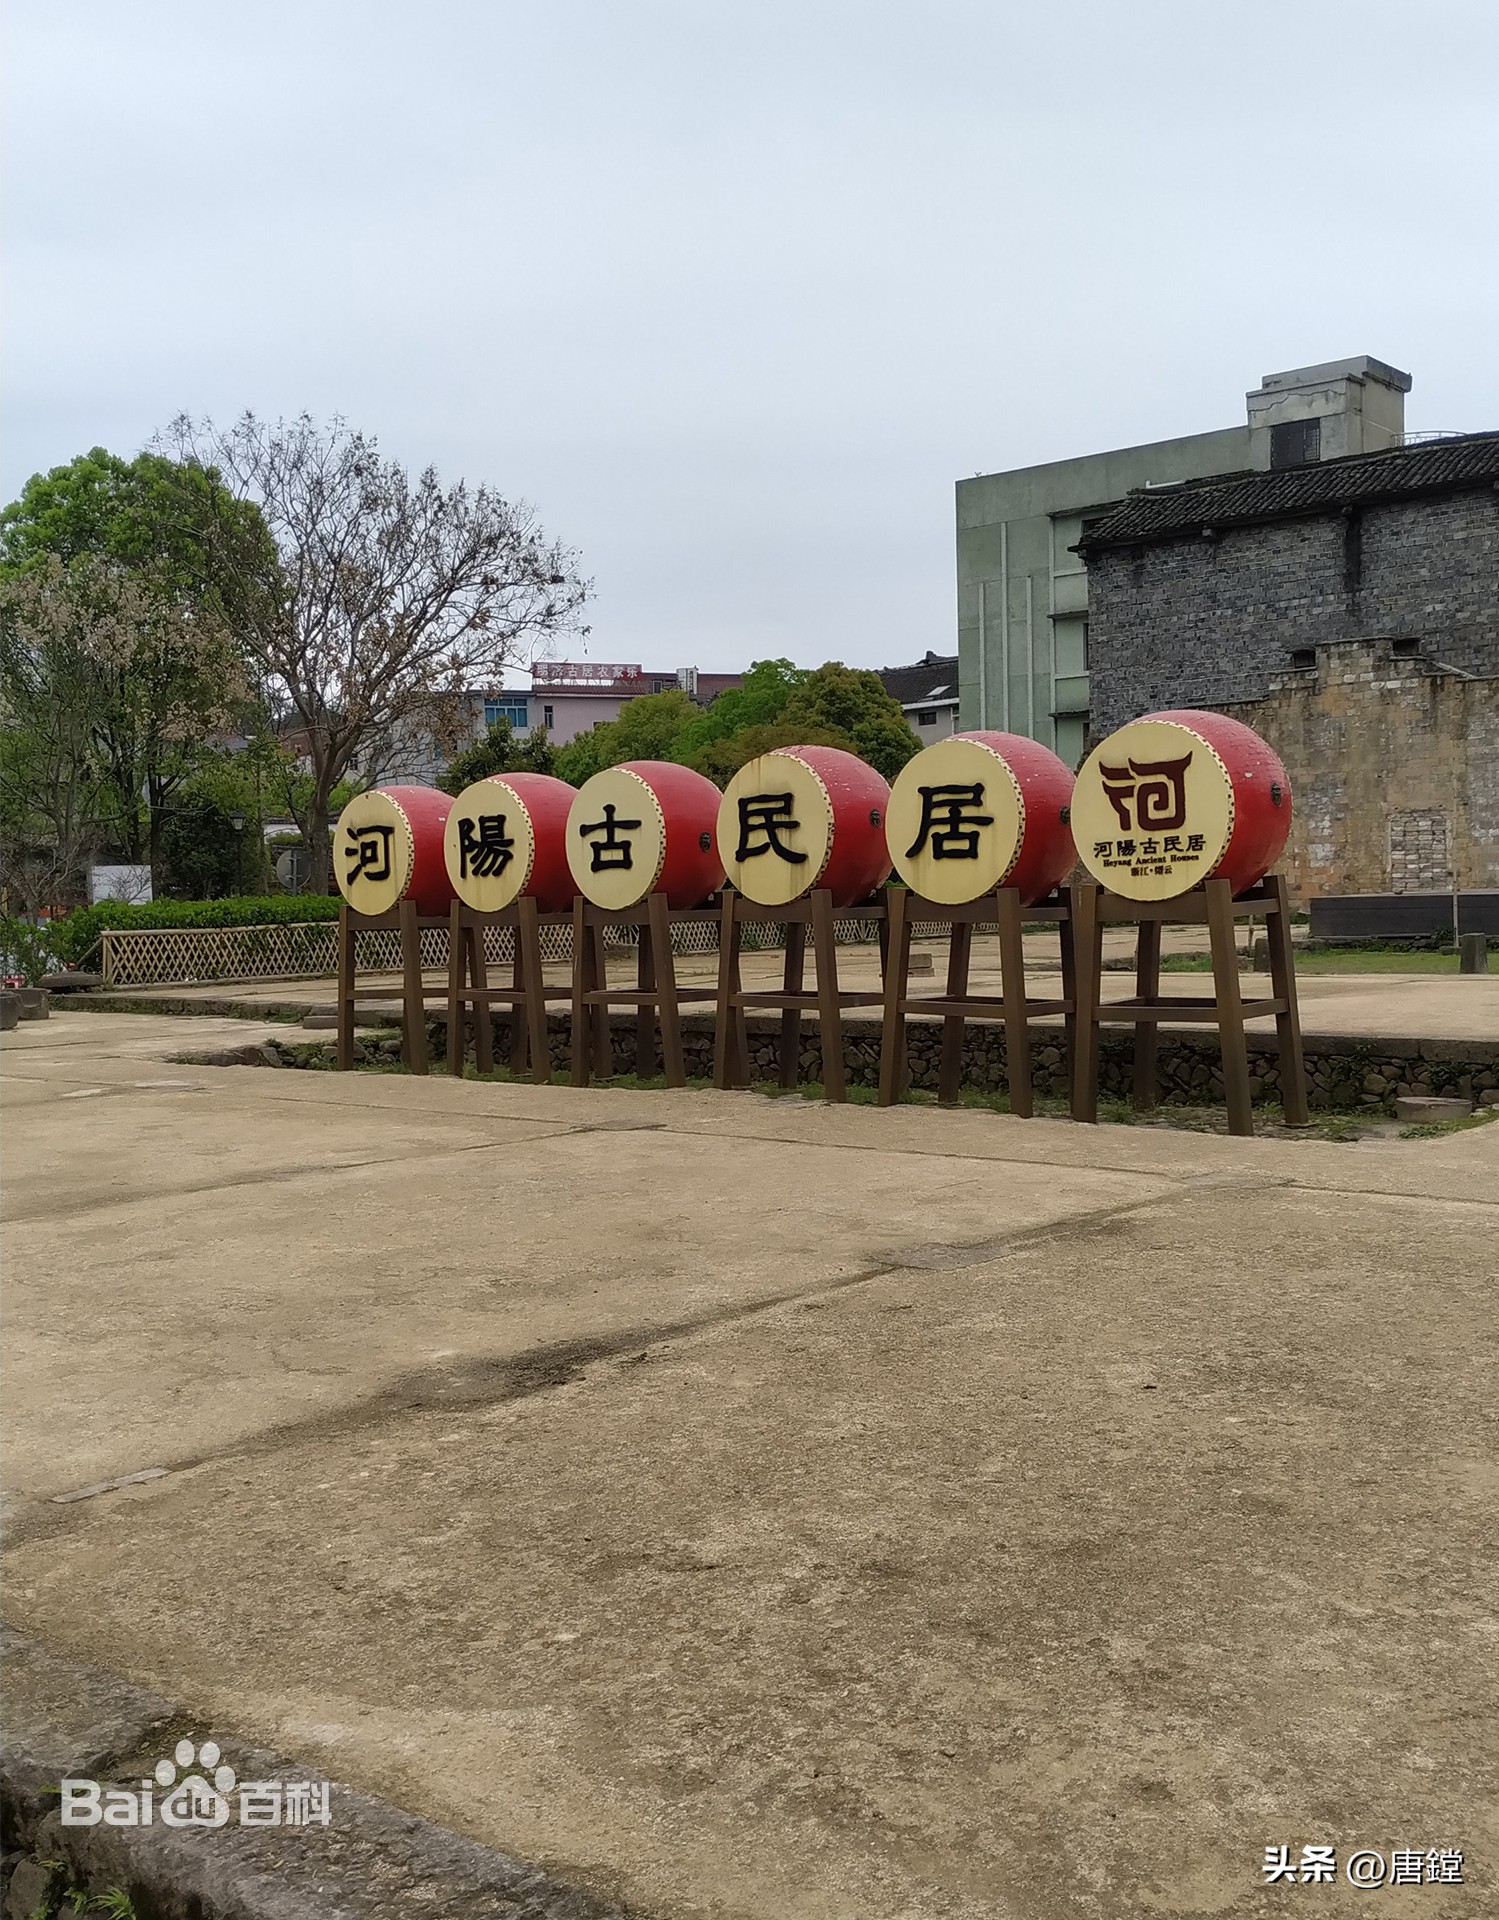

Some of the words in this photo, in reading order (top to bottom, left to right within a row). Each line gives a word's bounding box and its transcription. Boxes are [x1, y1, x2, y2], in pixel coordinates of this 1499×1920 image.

[344, 825, 396, 886] 河
[458, 813, 515, 879] 陽
[579, 803, 642, 873] 古
[734, 792, 809, 865] 民
[904, 782, 994, 861] 居
[1093, 834, 1207, 858] 河陽古民居
[1103, 858, 1132, 868] Heyang
[1135, 856, 1167, 865] Ancient
[1170, 853, 1200, 862] Houses
